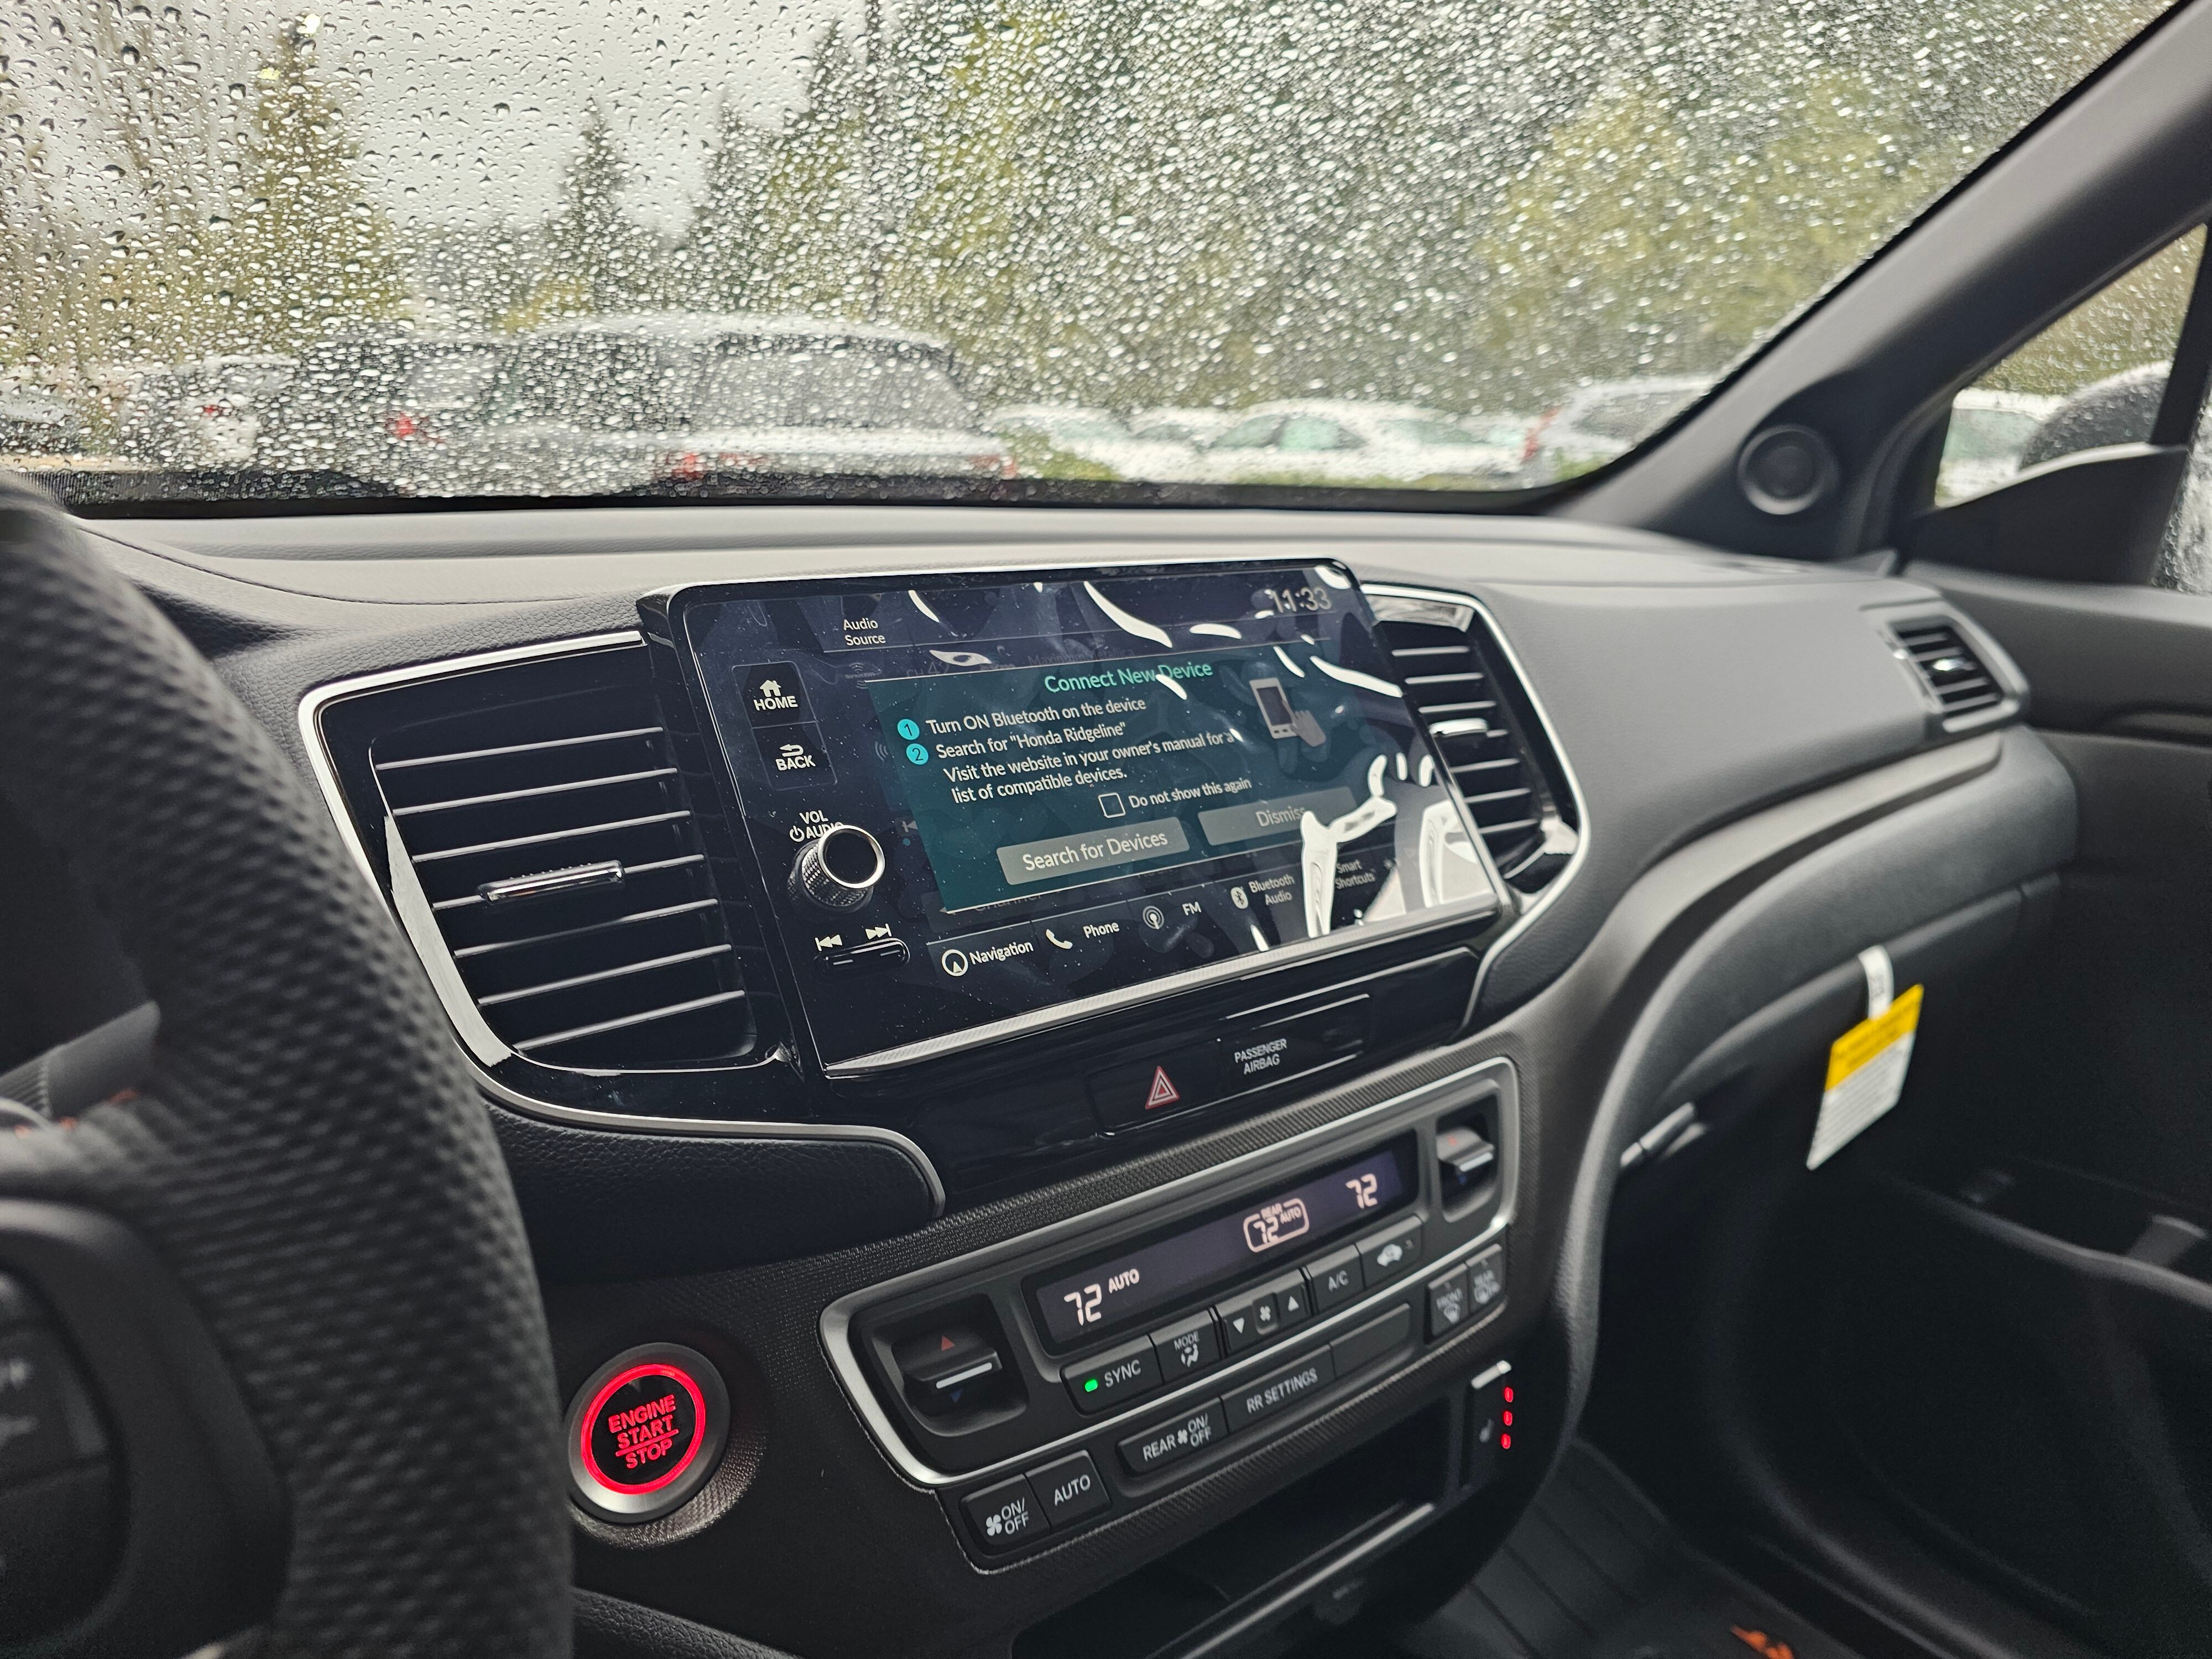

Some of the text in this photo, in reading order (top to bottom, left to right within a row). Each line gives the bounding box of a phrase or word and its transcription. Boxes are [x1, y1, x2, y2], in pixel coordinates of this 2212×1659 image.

[1267, 587, 1332, 613] 11:33
[843, 618, 879, 630] Audio
[845, 633, 886, 646] Source
[1044, 661, 1213, 693] Connect New Device
[753, 696, 798, 711] HOME
[904, 698, 1147, 737] 1 Turn ON Bluetooth on the device
[912, 721, 1126, 761] 2 Search for "Honda Ridgeline"
[776, 754, 816, 771] BACK
[943, 732, 1234, 782] Visit the website in your owner's manual for a
[951, 768, 1127, 804] list of compatible devices.
[1128, 778, 1252, 808] Do not show this again
[799, 810, 829, 824] VOL
[1022, 832, 1168, 871] Search for Devices
[1336, 859, 1362, 874] Smart
[1248, 874, 1295, 893] Bluetooth
[1334, 872, 1375, 889] Shortcuts
[1182, 902, 1202, 916] FM
[1265, 890, 1292, 906] Audio
[1083, 920, 1120, 939] Phone
[969, 940, 1034, 966] Navigation
[1234, 1038, 1287, 1063] PASSENGER
[1244, 1053, 1280, 1074] AIRBAG
[1345, 1173, 1378, 1209] 72
[1280, 1206, 1302, 1224] AUTO
[1253, 1216, 1279, 1244] 72
[1327, 1270, 1349, 1292] A/C
[1063, 1267, 1140, 1326] 72 AUTO
[1174, 1331, 1200, 1352] MODE
[1104, 1360, 1141, 1387] SYNC
[1246, 1368, 1318, 1414] RR SETTINGS
[608, 1394, 676, 1433] ENGINE
[1188, 1413, 1209, 1432] ON/
[617, 1415, 674, 1449] START
[1190, 1427, 1212, 1448] OFF
[625, 1438, 672, 1469] STOP
[1142, 1439, 1176, 1463] REAR
[1053, 1474, 1091, 1506] AUTO
[1001, 1497, 1025, 1521] ON/
[1004, 1511, 1029, 1536] OFF
